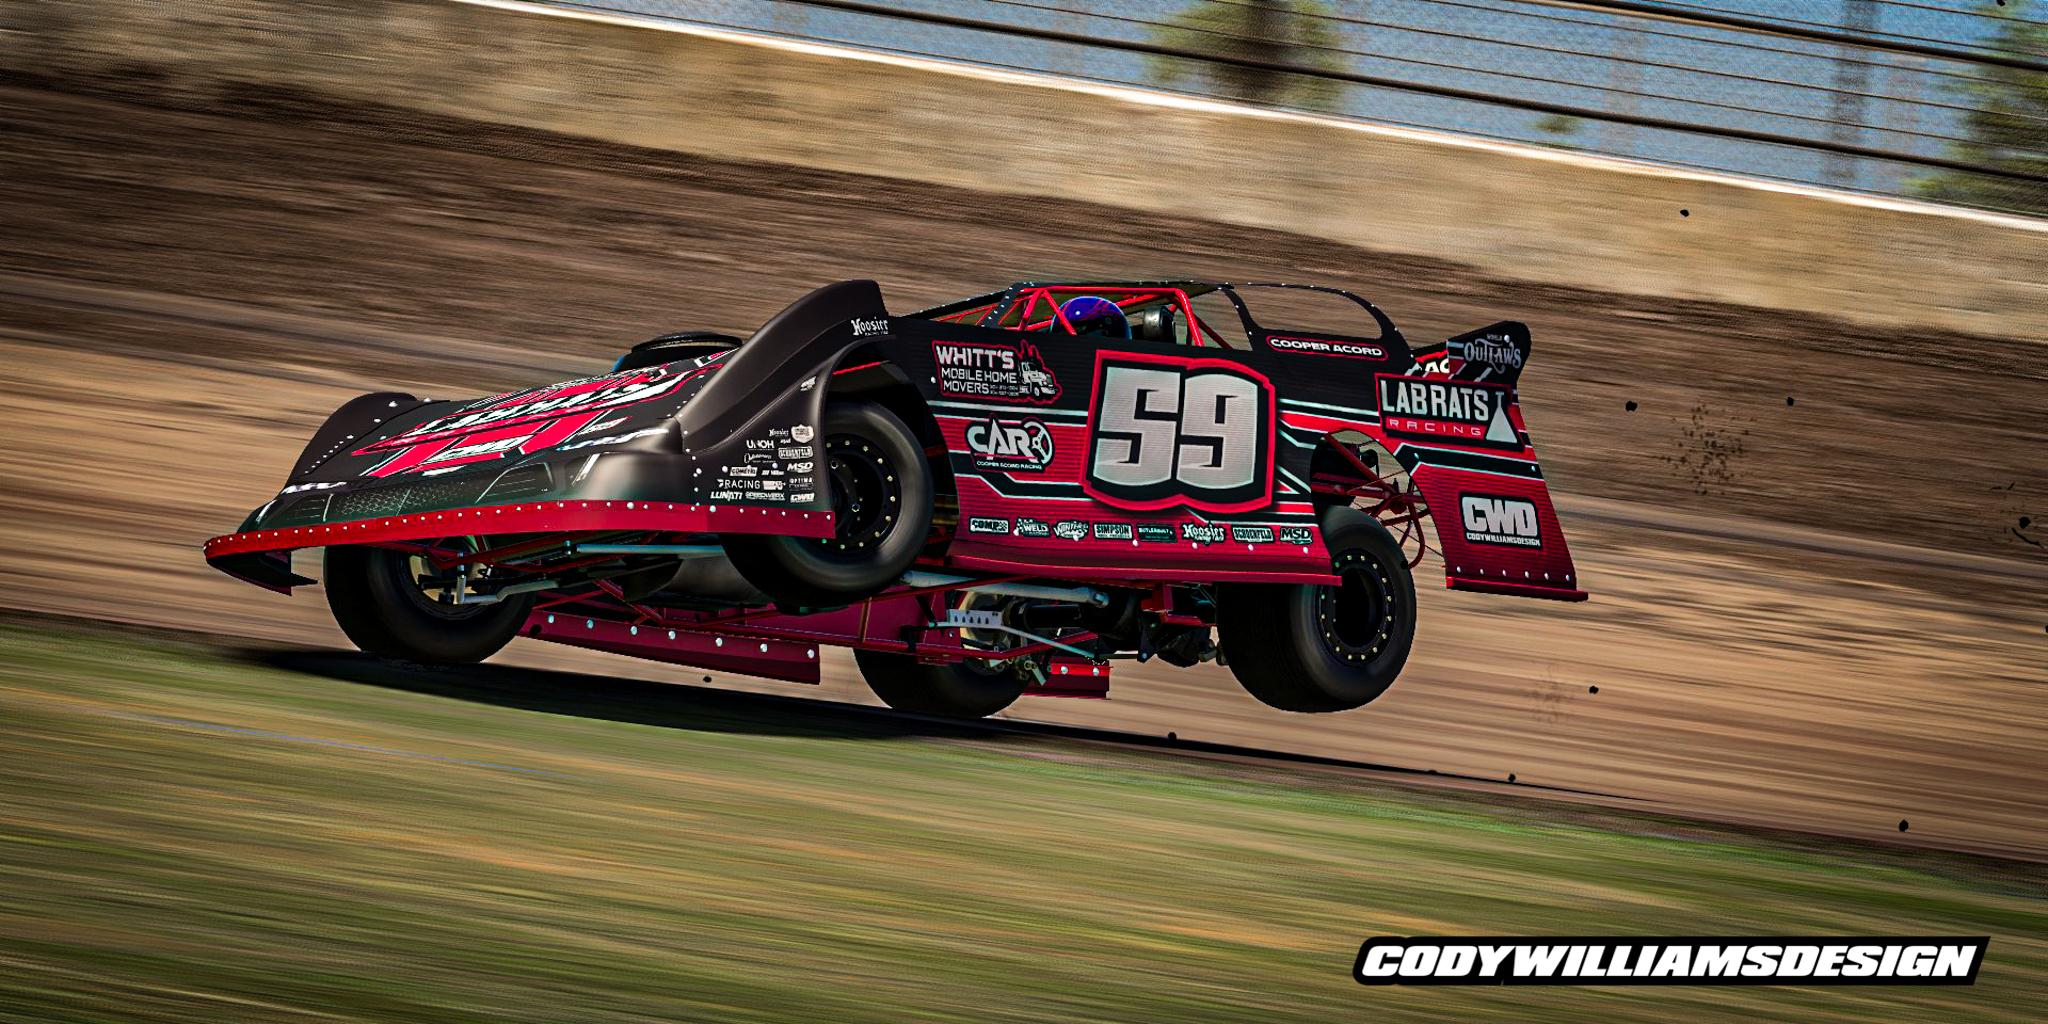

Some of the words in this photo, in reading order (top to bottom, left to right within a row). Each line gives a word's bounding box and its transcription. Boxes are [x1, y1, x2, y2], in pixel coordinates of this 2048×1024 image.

[1270, 338, 1331, 352] COOPER
[1333, 344, 1383, 357] ACORD
[941, 367, 984, 382] MOBILE
[984, 370, 1018, 384] HOME
[943, 380, 990, 395] MOVERS
[1093, 366, 1259, 489] 59
[1389, 419, 1482, 436] RACING
[787, 462, 814, 473] MSD
[724, 479, 760, 489] RACING
[1461, 496, 1538, 537] CWD
[1096, 524, 1129, 535] SIMPSON
[1281, 528, 1312, 540] MSD
[1466, 532, 1541, 547] CODYWILLIAMSDESIGN
